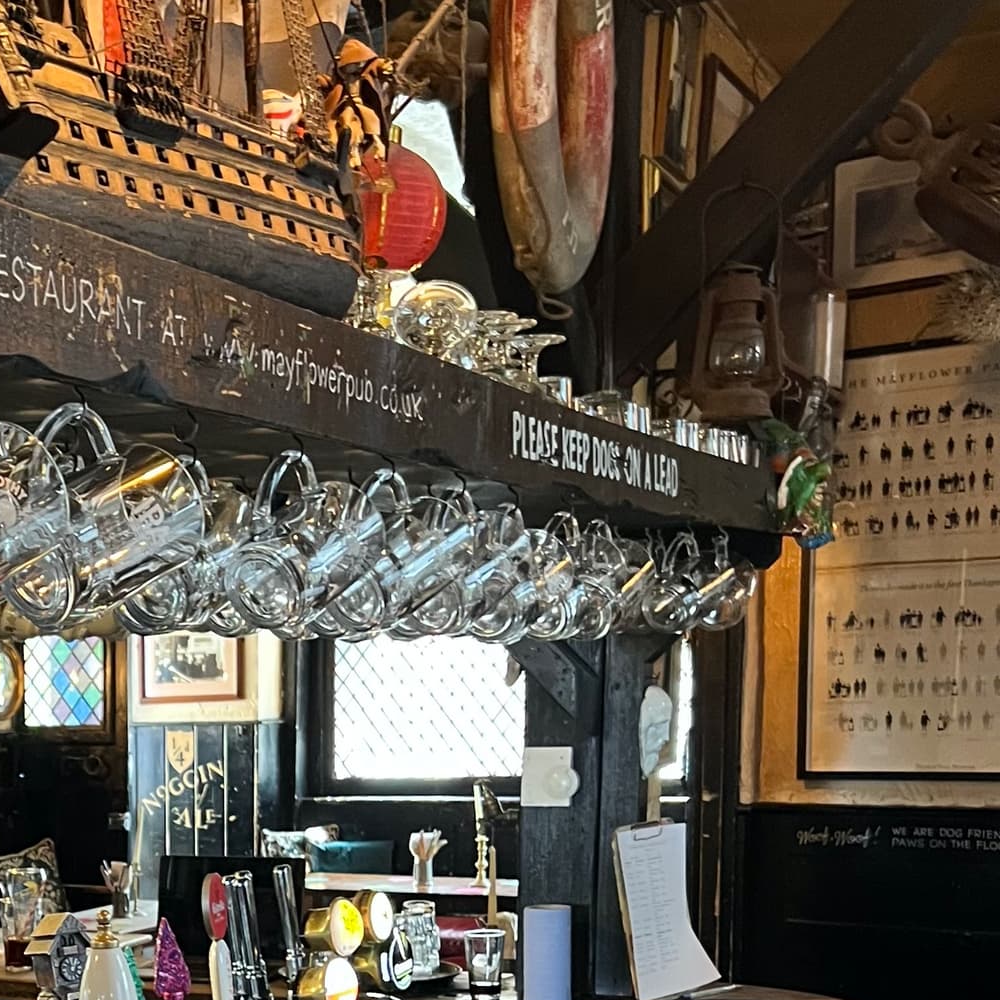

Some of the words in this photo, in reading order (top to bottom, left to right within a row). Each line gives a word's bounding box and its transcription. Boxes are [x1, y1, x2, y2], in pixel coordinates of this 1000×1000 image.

[161, 313, 187, 347] AT
[512, 410, 559, 468] PLEASE
[561, 427, 591, 474] KEEP
[592, 436, 621, 482] DOGS
[624, 445, 642, 488] ON
[644, 452, 653, 492] A
[653, 453, 679, 498] LEAD
[141, 760, 225, 816] NOGGIN
[891, 827, 907, 837] WE
[913, 827, 935, 837] ARE
[939, 828, 963, 839] DOG
[891, 838, 926, 849] PAWS
[929, 839, 947, 849] ON
[951, 840, 972, 850] THE
